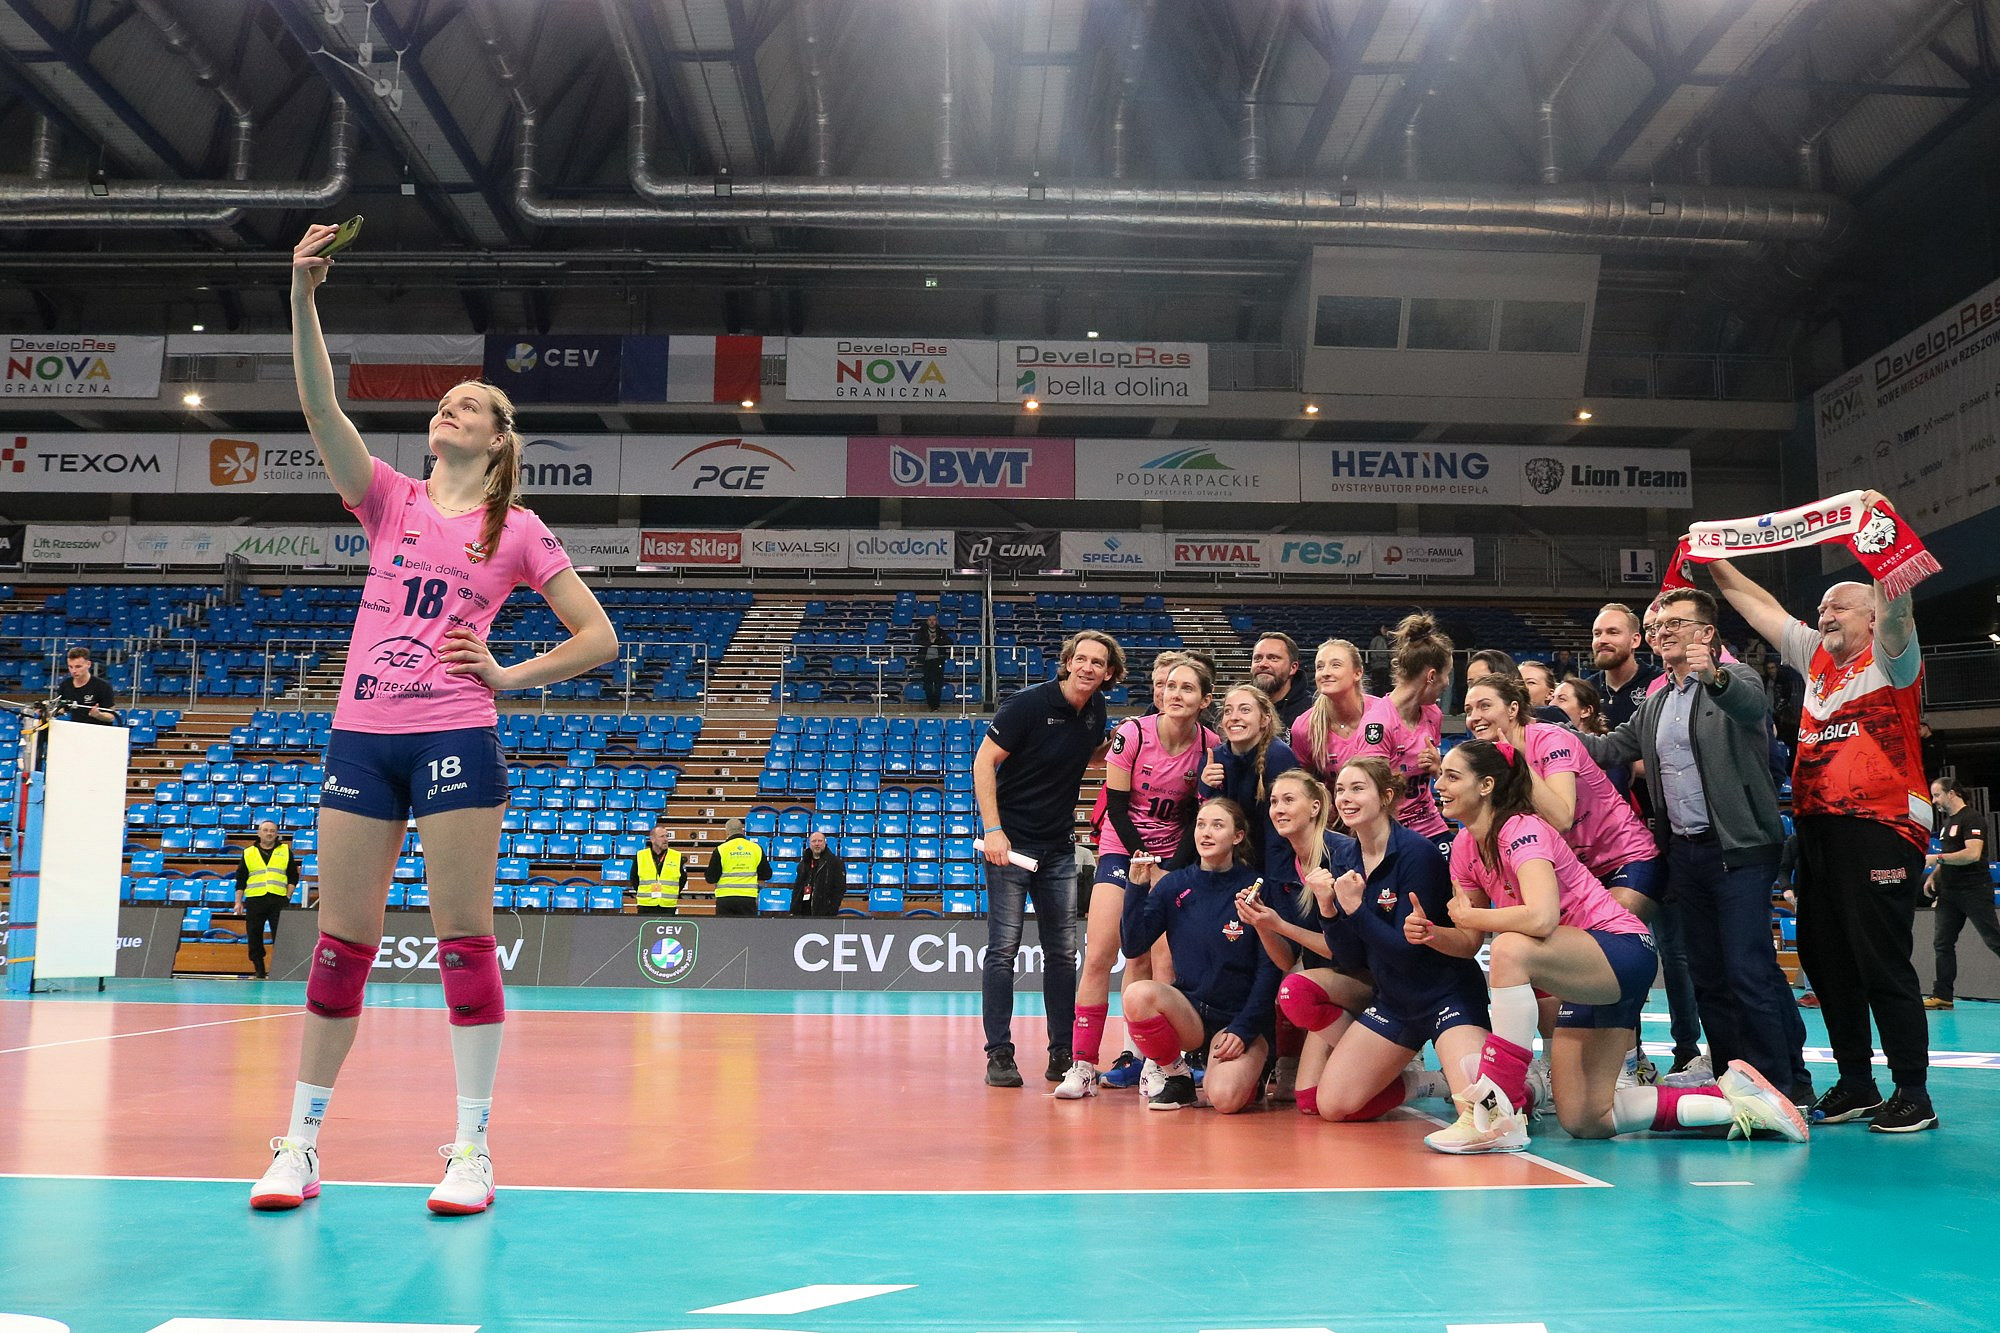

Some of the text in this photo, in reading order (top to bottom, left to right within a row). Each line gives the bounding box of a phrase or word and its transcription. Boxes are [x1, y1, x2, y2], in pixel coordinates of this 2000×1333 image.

[10, 338, 117, 353] DevelopRes
[837, 341, 948, 355] DevelopRes
[544, 349, 600, 368] CEV
[1016, 345, 1192, 368] DevelopRes
[7, 356, 112, 381] NOVA
[836, 359, 946, 384] NOVA
[5, 383, 111, 395] GRANICZNA
[836, 387, 948, 398] GRANICZNA
[1046, 375, 1190, 398] bella dolina
[1877, 387, 1900, 409] NOWE
[1900, 359, 1949, 396] MIESZKANIA
[37, 453, 161, 473] TEXOM
[929, 449, 1030, 486] BWT
[1331, 450, 1490, 480] HEATING
[263, 469, 303, 480] stolica
[692, 466, 770, 490] PGE
[1116, 472, 1260, 488] PODKARPACKIE
[1571, 464, 1688, 489] Lion Team
[1331, 483, 1489, 495] DYSTRYBUTOR POMP CIEPŁA
[1698, 505, 1852, 548] K.S. DevelopRes
[33, 538, 101, 549] Lift Rzeszów
[233, 535, 320, 555] MARCEL
[401, 537, 417, 546] POL
[567, 545, 630, 555] PRO-FAMILIA
[643, 537, 739, 560] Nasz Sklep
[999, 544, 1047, 557] CUNA
[32, 551, 62, 559] Orona
[1082, 553, 1144, 564] SPECJAŁ
[1174, 544, 1261, 562] RYWAL
[1280, 540, 1363, 567] res.pl
[1406, 547, 1464, 557] PRO-FAMILIA
[405, 558, 470, 581] bella dolina
[1644, 561, 1653, 574] 3
[402, 575, 449, 620] 18
[374, 650, 424, 669] PGE
[377, 681, 433, 692] rzeszów
[427, 755, 463, 782] 18
[328, 784, 360, 796] OLIMP
[440, 781, 468, 793] CUNA
[1147, 797, 1175, 821] 10
[1510, 834, 1539, 851] BWT
[656, 925, 683, 935] CEV
[793, 932, 895, 973] CEV
[1441, 1011, 1461, 1022] CUNA
